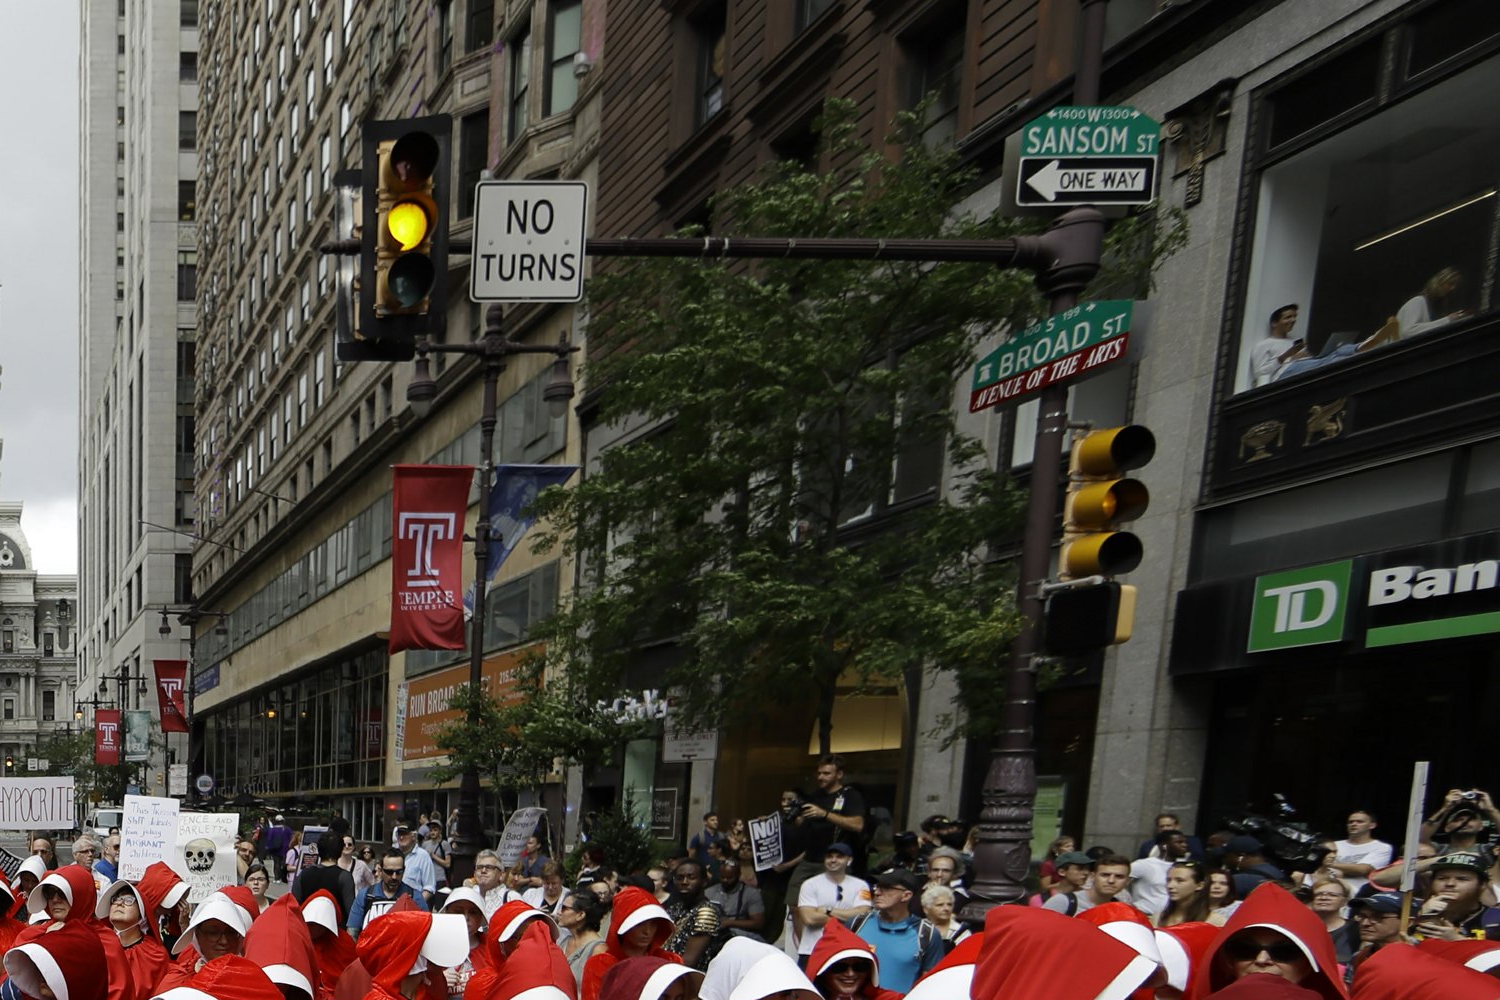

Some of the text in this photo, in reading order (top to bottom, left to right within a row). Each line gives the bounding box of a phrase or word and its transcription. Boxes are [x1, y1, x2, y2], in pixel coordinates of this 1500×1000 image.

[1058, 109, 1086, 120] 1400
[1087, 108, 1101, 123] W
[1026, 126, 1157, 154] SANSOM ST
[1059, 170, 1141, 190] ONE WAY
[506, 198, 555, 236] NO
[480, 253, 576, 283] TURNS
[1023, 306, 1081, 337] 100 S 199
[998, 312, 1127, 379] BROAD ST
[972, 336, 1126, 411] AVENUE OF THE ARTS
[1263, 559, 1500, 634] TD Ban
[409, 694, 427, 719] RUN
